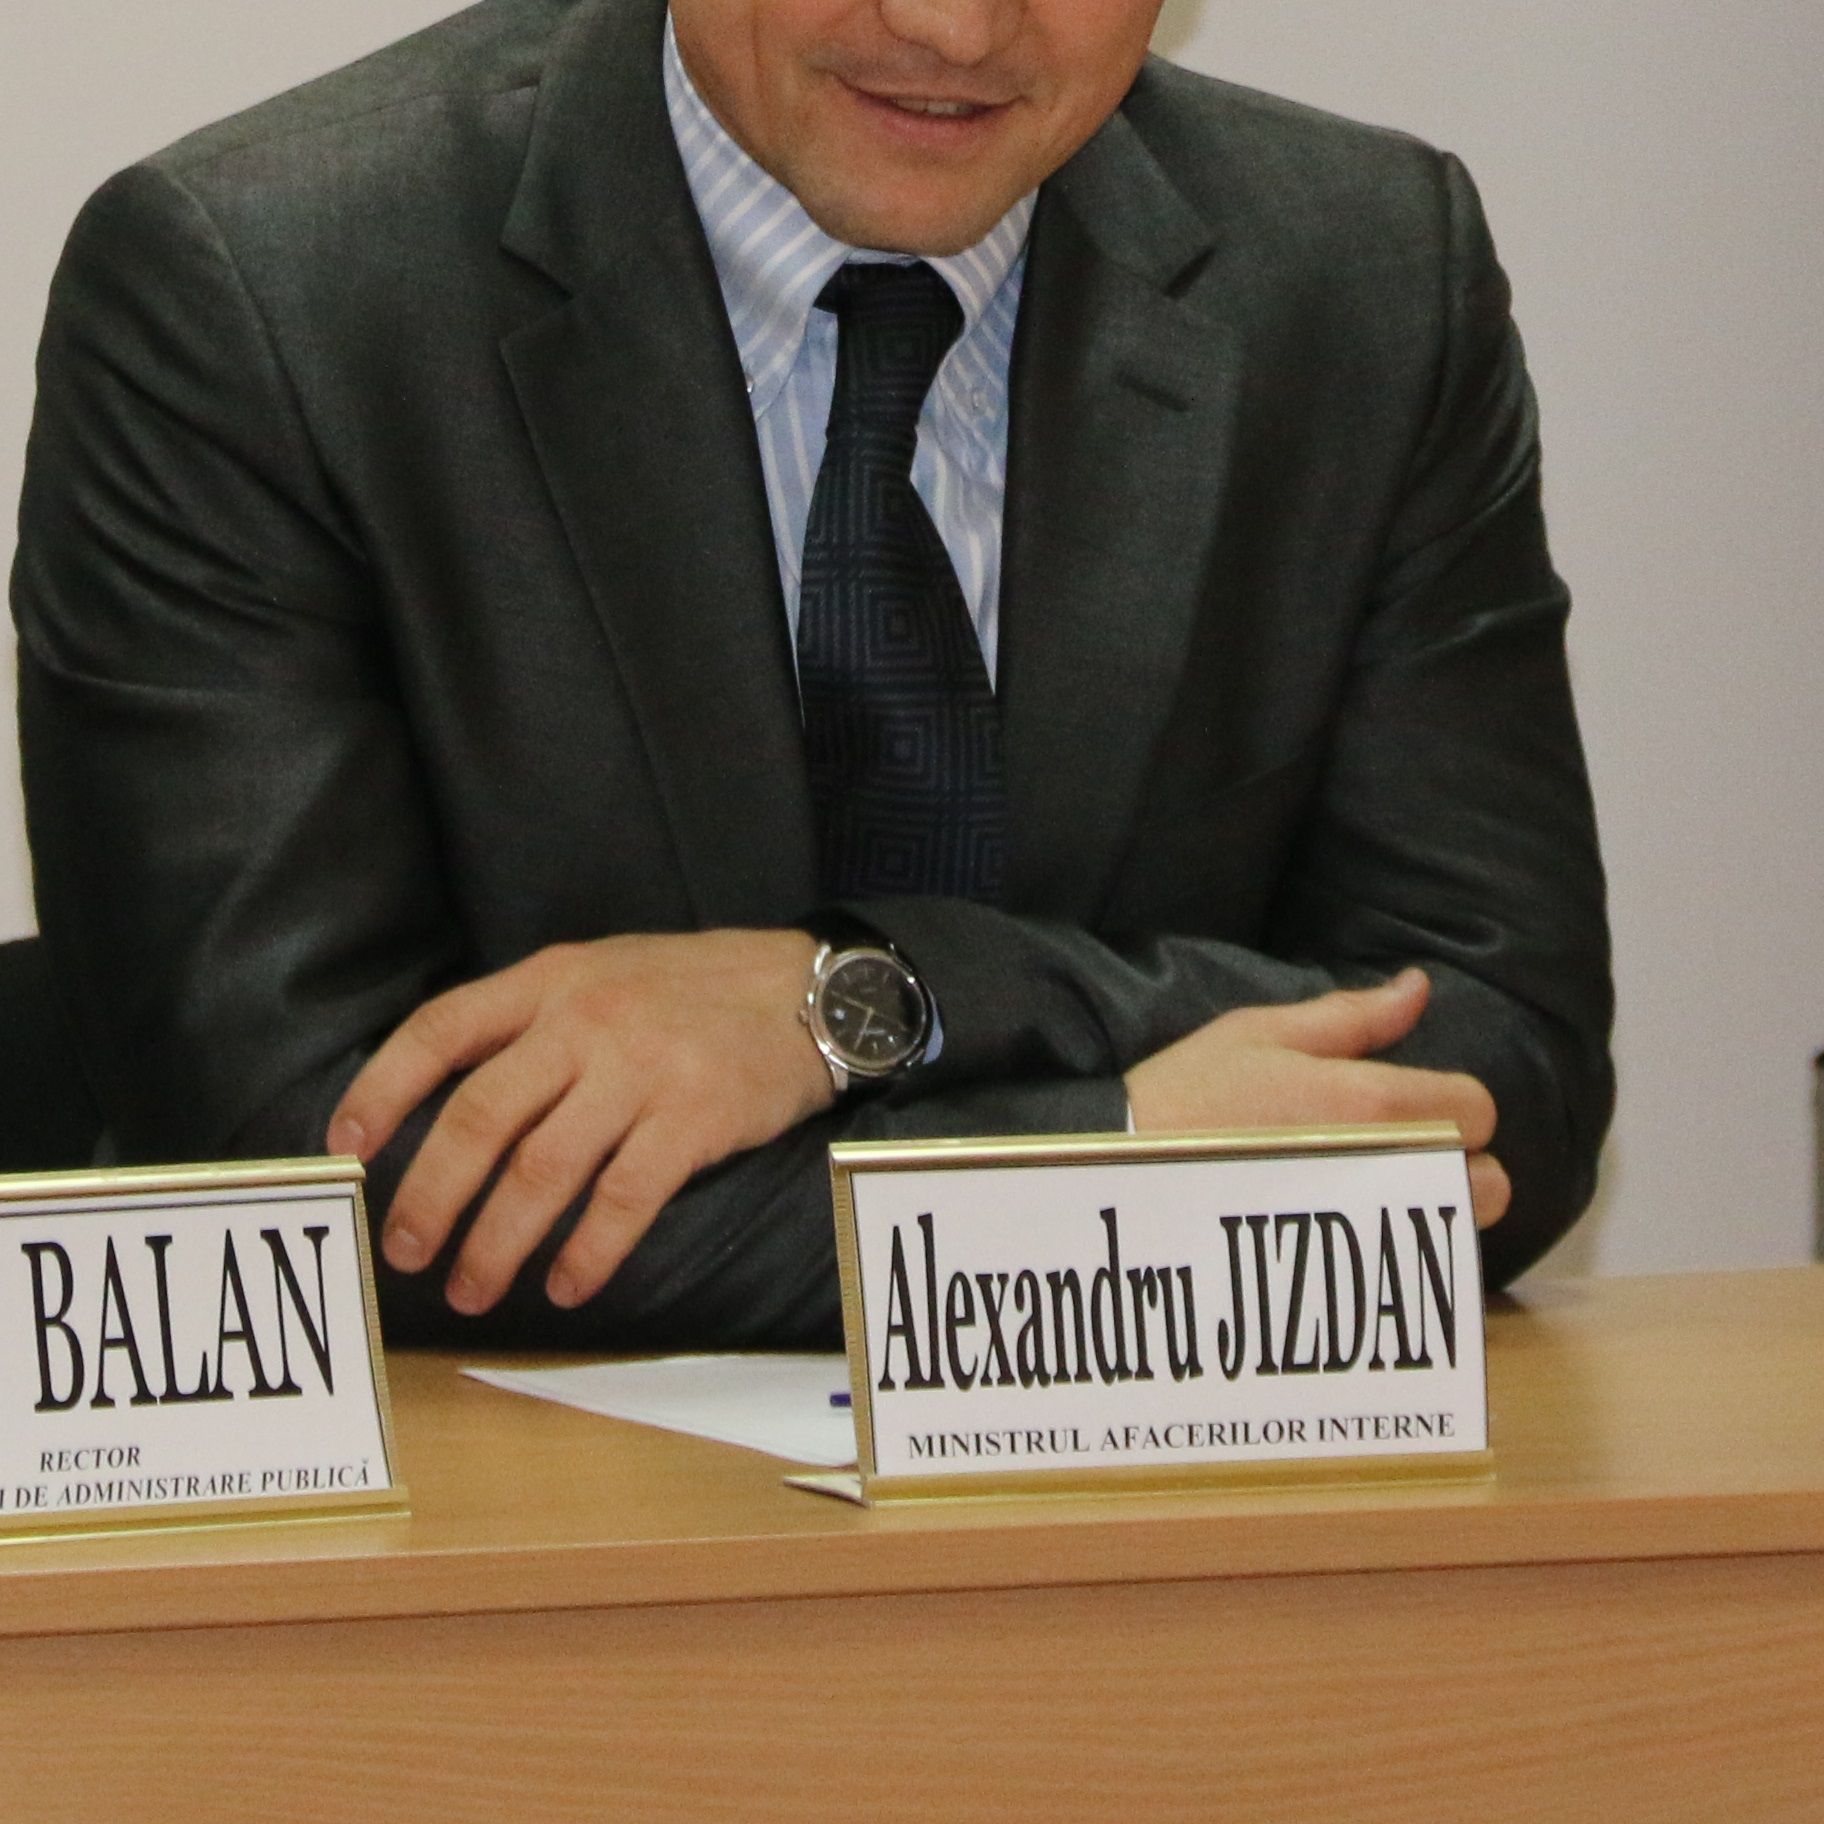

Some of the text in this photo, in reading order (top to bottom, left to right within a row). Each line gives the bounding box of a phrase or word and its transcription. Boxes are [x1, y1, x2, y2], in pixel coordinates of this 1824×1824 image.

[21, 1225, 337, 1412] BALAN
[878, 1205, 1456, 1392] Alexandru JIZDAN
[40, 1446, 142, 1473] RECTOR
[908, 1412, 1456, 1460] MINISTRUL AFACERILOR INTERNE
[15, 1485, 49, 1509] DE
[57, 1471, 253, 1507] ADMINISTRARE
[260, 1458, 371, 1492] PUBLICĂ
